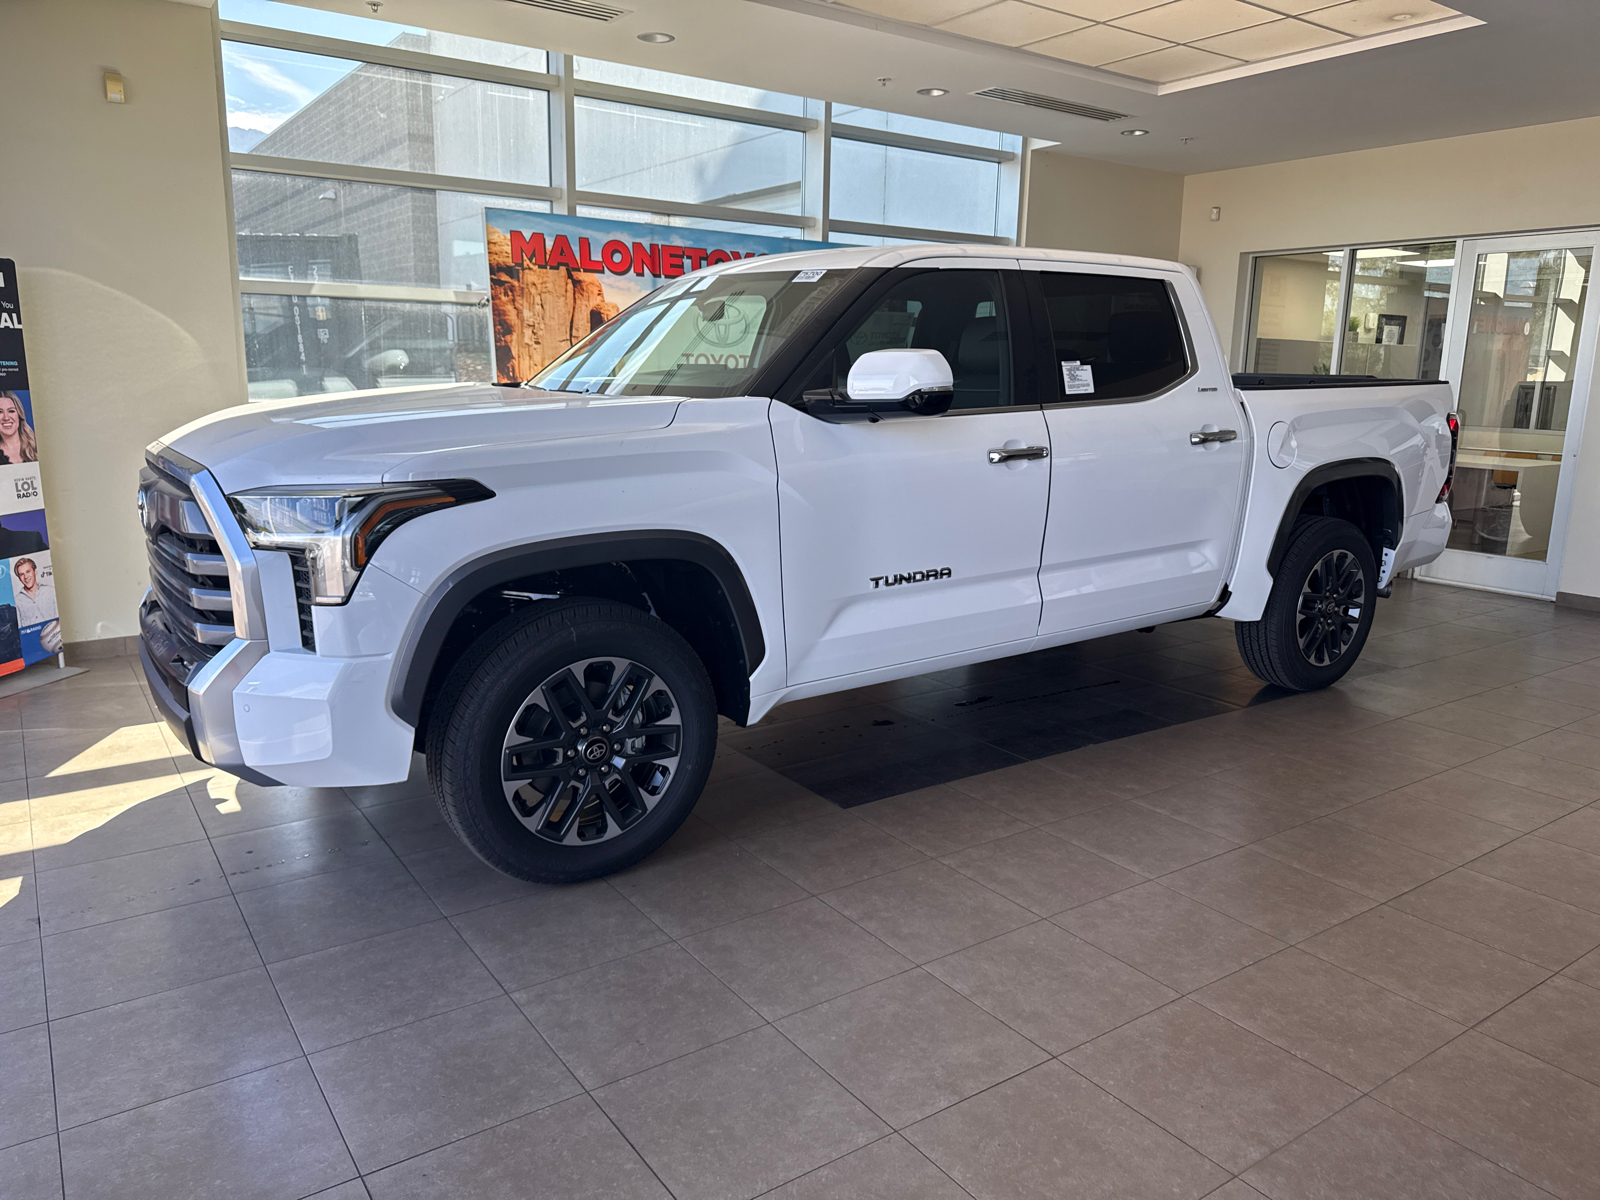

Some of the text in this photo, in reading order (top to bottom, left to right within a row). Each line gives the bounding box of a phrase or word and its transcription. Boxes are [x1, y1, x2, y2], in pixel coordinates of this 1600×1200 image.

[509, 230, 769, 278] MALONETO
[0, 301, 14, 309] You
[15, 480, 37, 493] LOL
[16, 490, 38, 500] RADIO
[869, 566, 952, 589] TUNDRA
